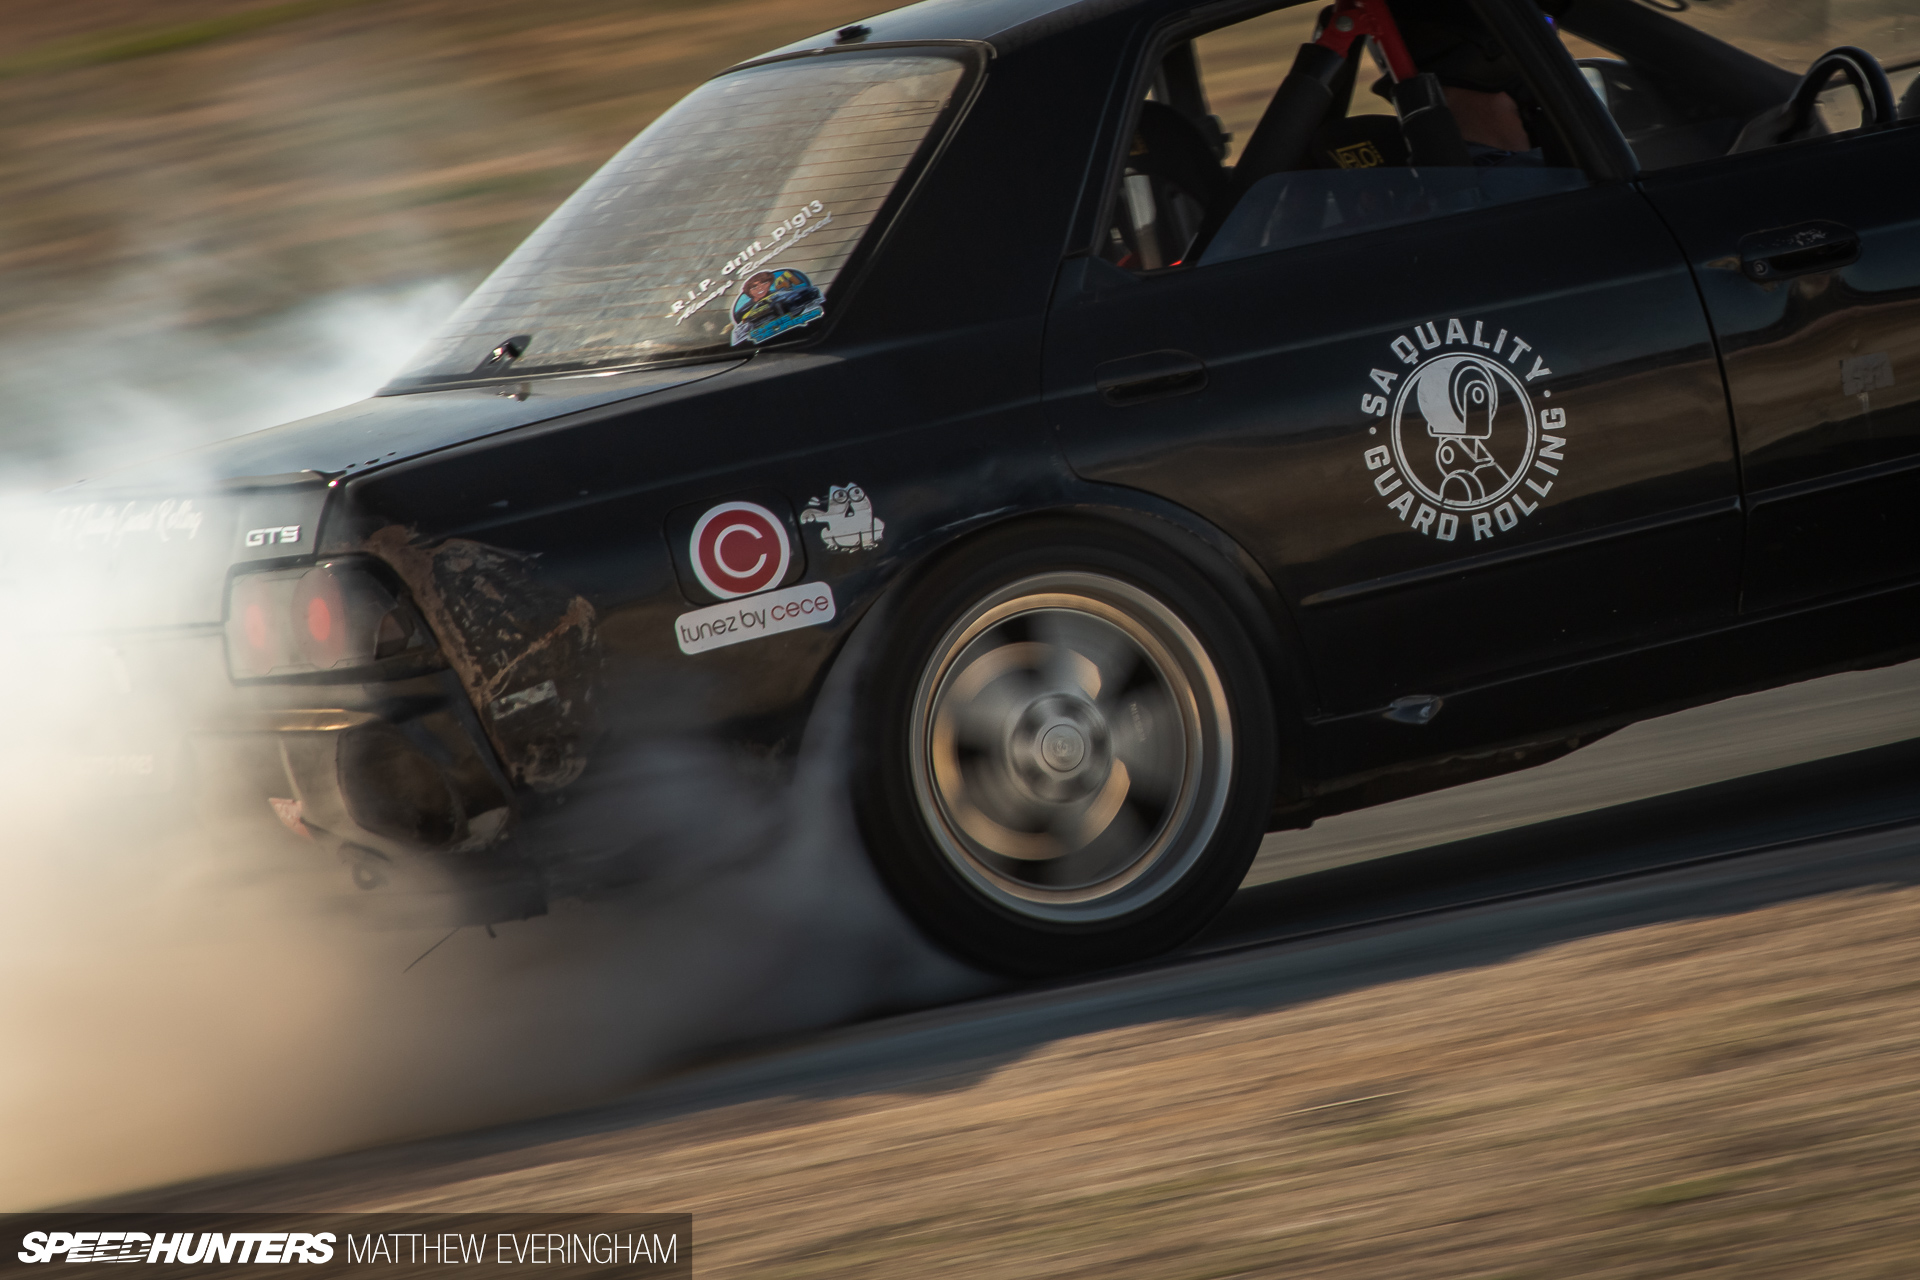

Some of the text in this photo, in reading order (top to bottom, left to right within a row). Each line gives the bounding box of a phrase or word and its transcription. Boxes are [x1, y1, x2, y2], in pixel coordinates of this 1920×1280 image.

[670, 278, 716, 314] R.I.P.
[675, 211, 833, 326] Always Remembered
[1361, 318, 1552, 417] SA QUALITY
[1363, 407, 1567, 541] GUARD ROLLING
[245, 524, 301, 547] GTS
[680, 595, 829, 643] tunez by cece
